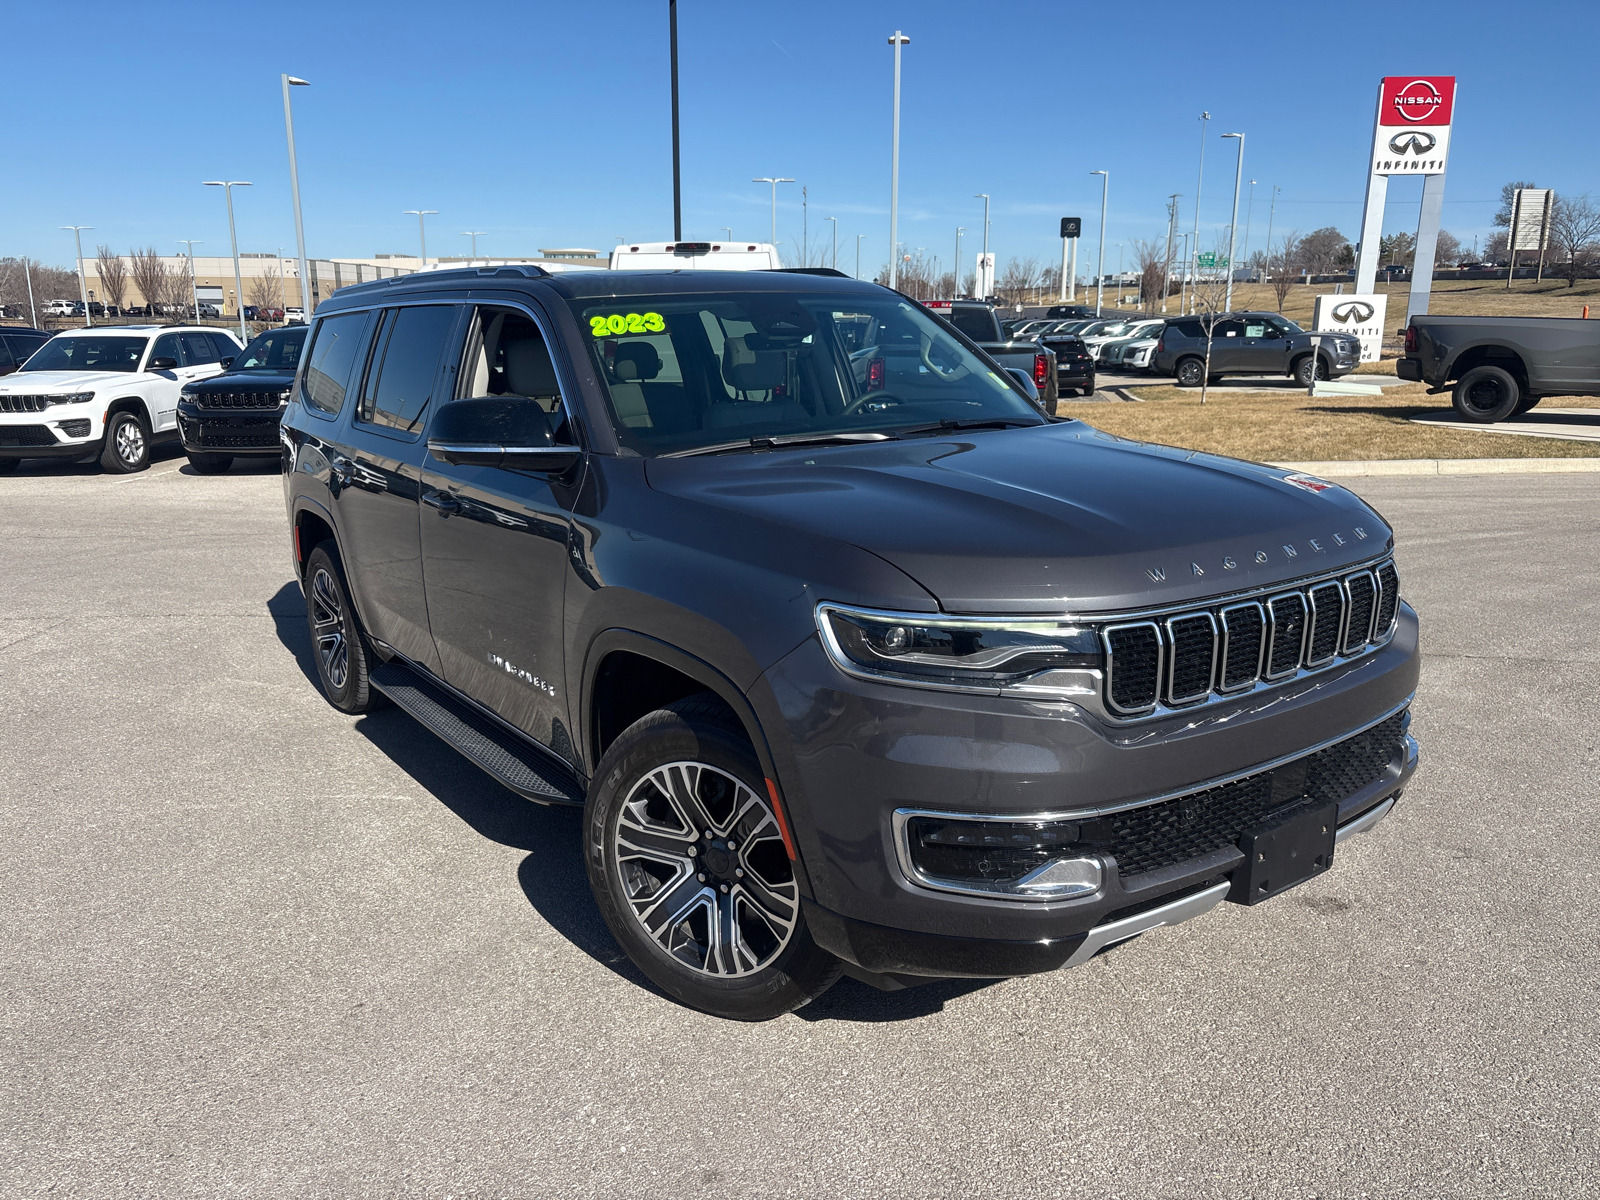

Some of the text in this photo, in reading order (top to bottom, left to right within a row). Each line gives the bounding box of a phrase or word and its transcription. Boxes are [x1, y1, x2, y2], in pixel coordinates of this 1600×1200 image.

[1376, 160, 1443, 170] INFINITI
[590, 312, 665, 337] 2023
[1145, 526, 1368, 583] WAGONEER
